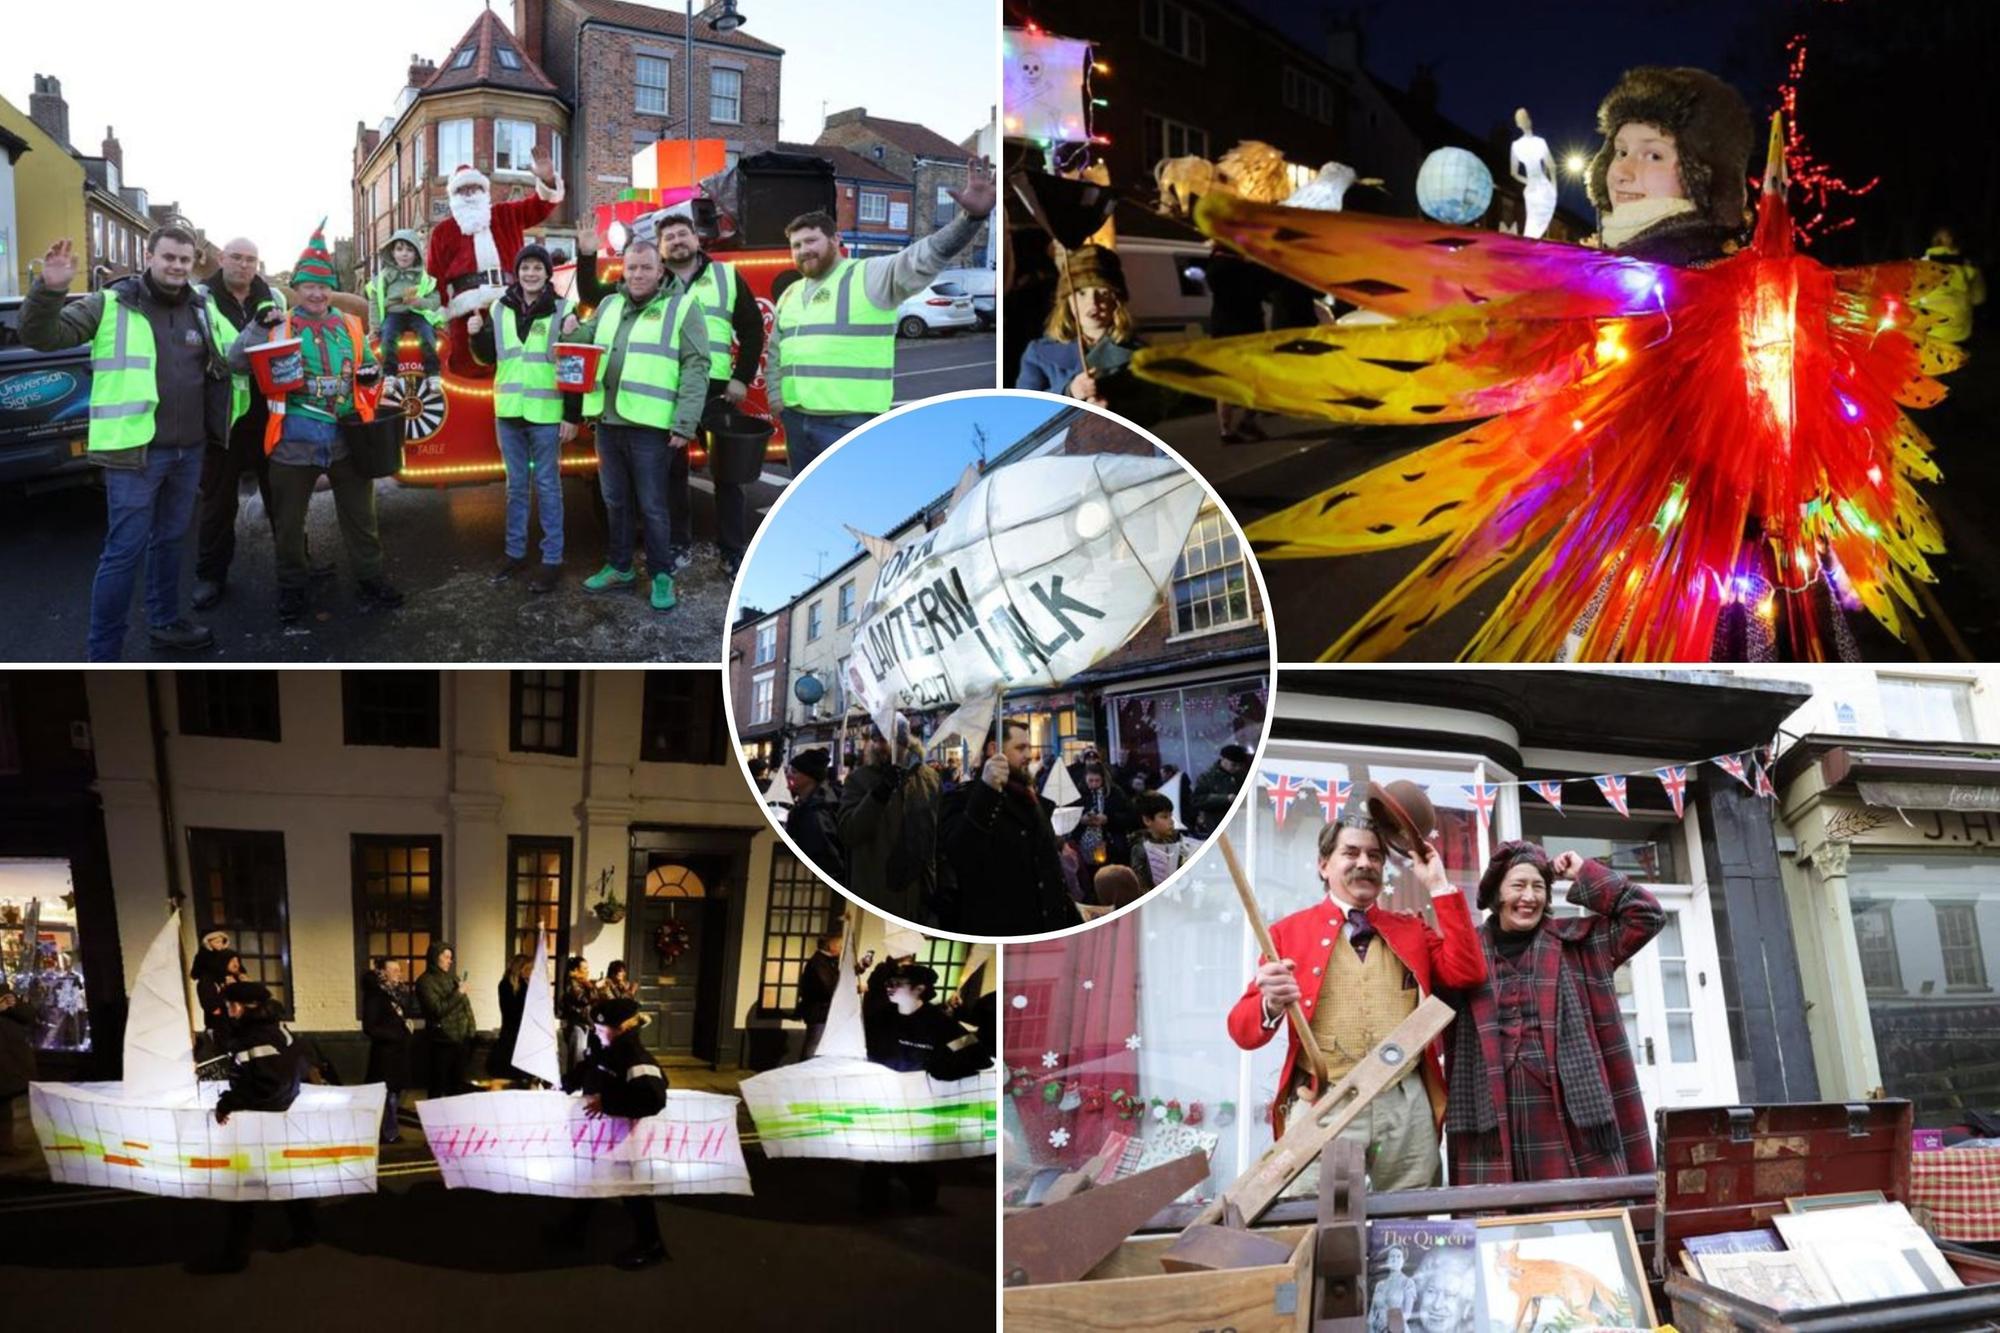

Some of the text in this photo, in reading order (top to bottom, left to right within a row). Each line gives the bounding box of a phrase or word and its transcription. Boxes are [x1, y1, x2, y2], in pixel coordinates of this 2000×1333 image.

[2, 392, 41, 409] Signs
[861, 566, 1106, 683] LANTERN WALK
[912, 673, 952, 706] 2017
[1924, 810, 2000, 842] J.H
